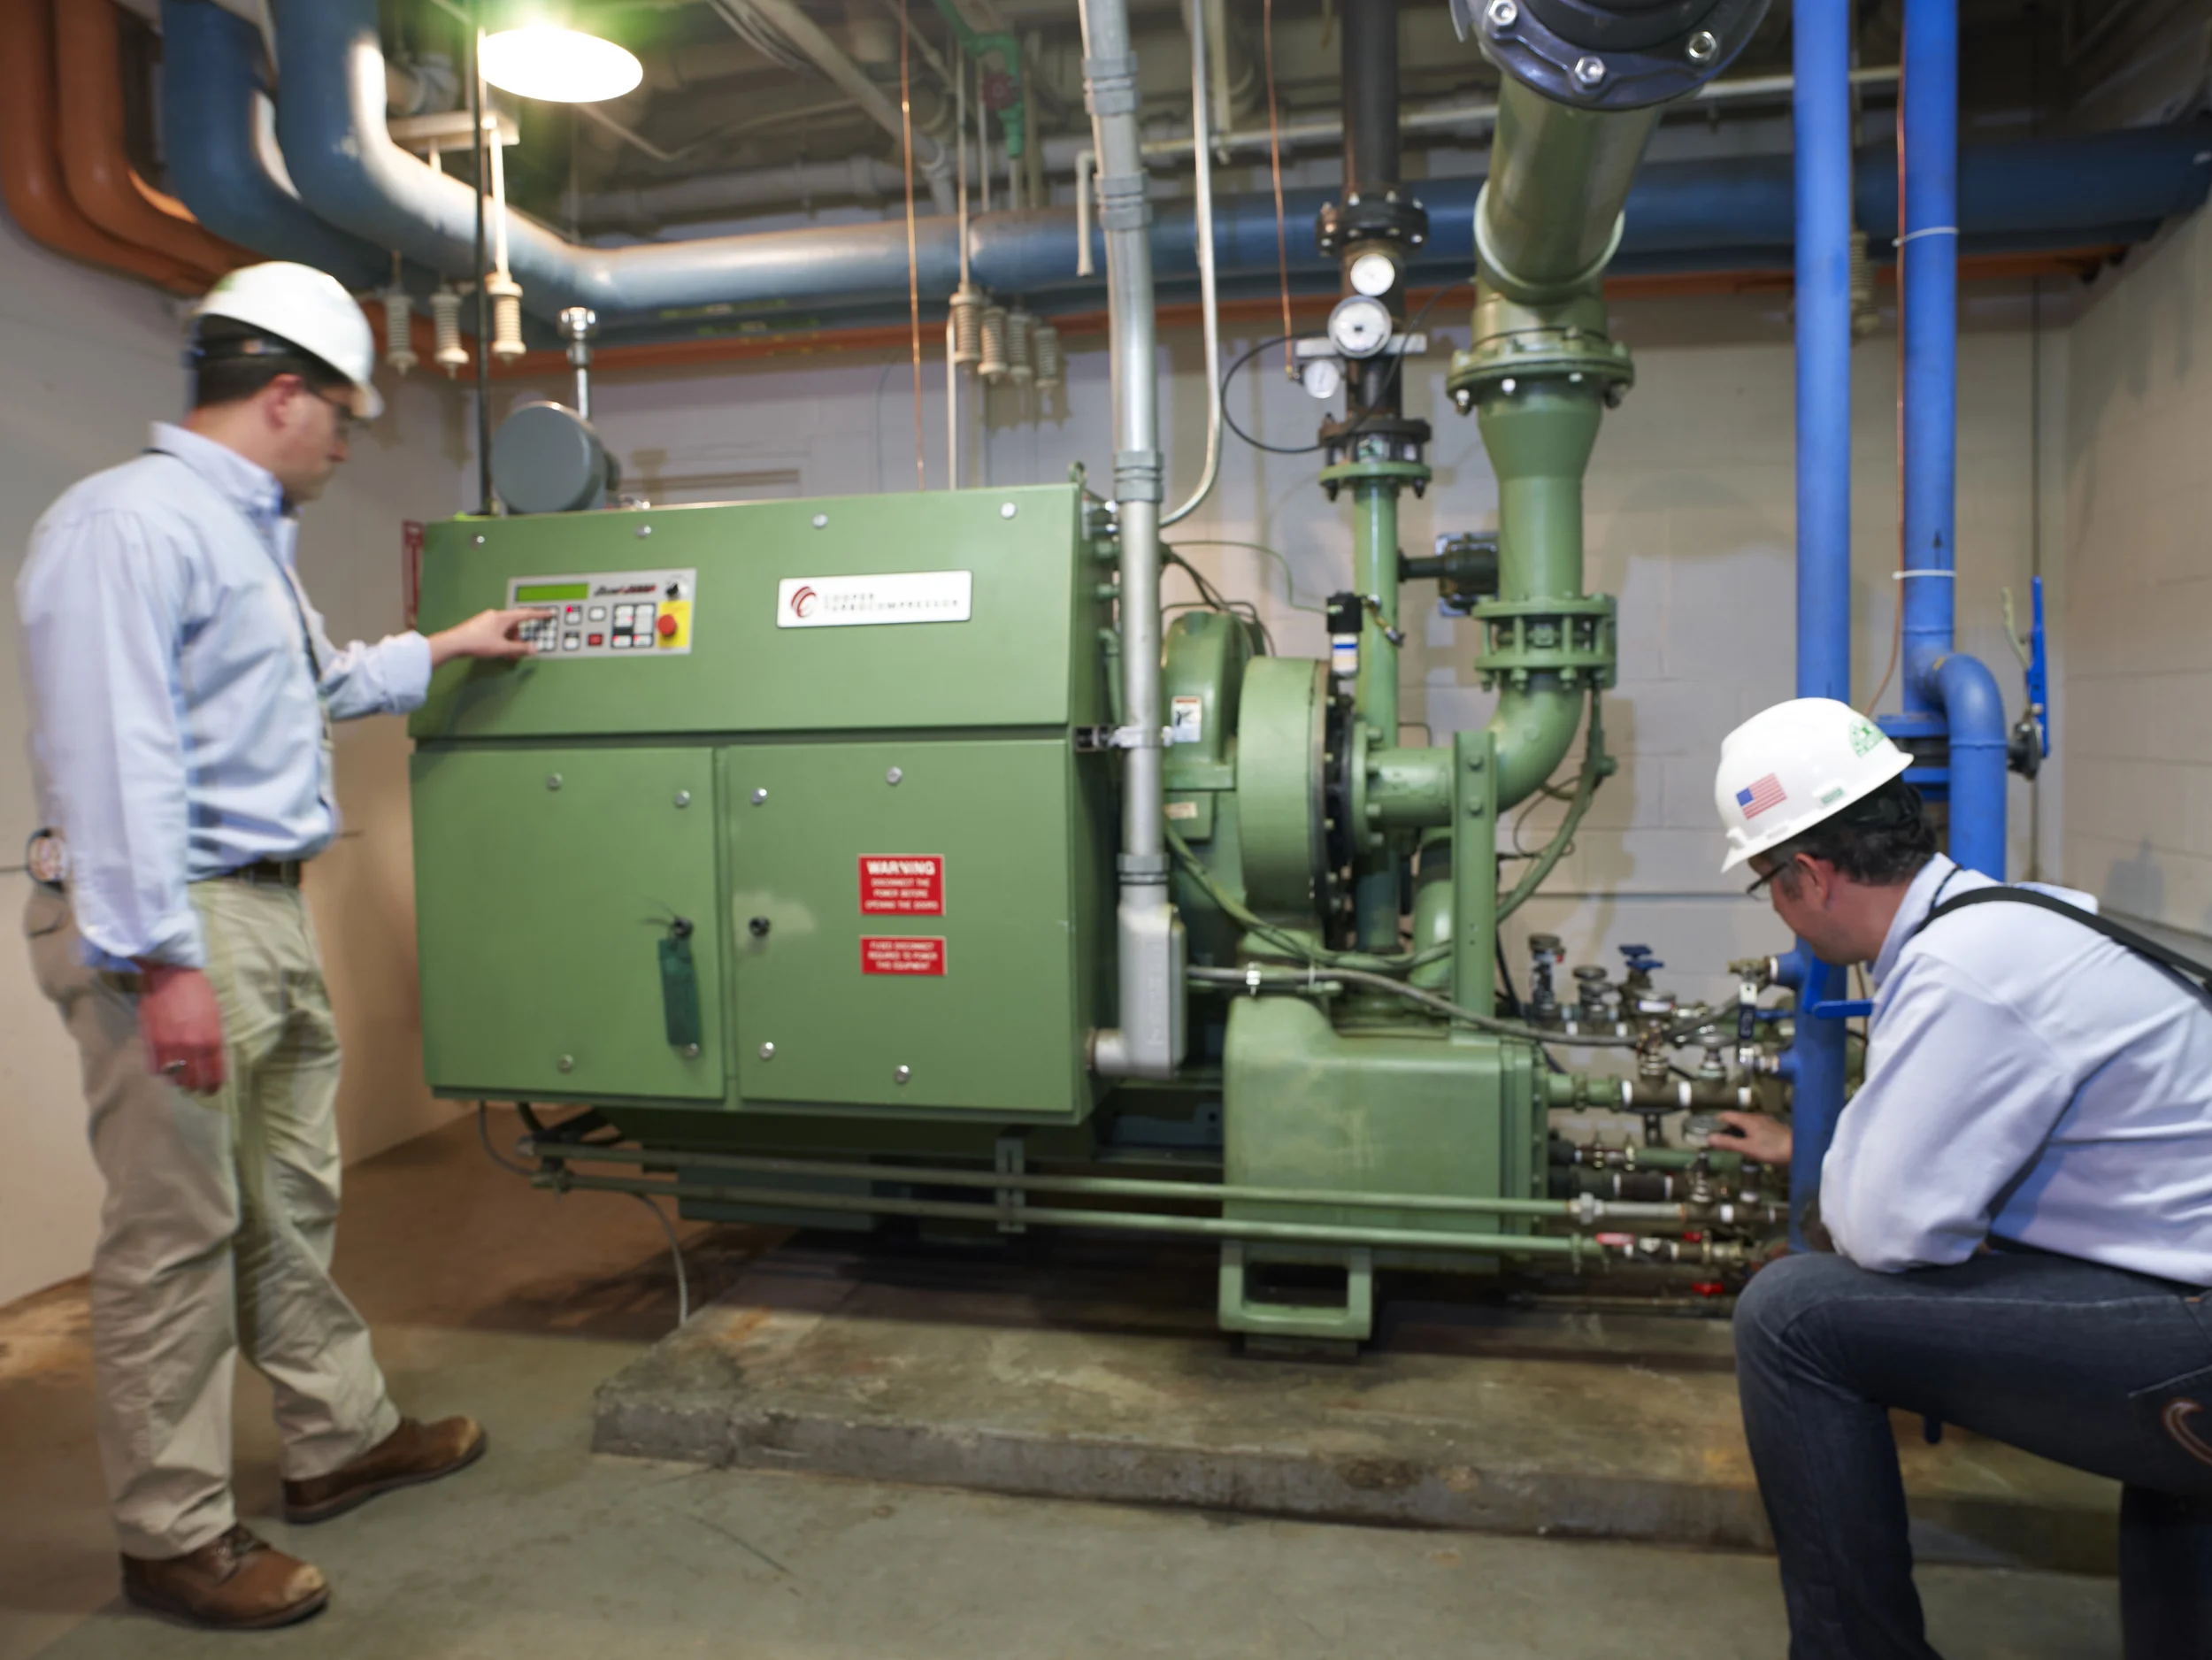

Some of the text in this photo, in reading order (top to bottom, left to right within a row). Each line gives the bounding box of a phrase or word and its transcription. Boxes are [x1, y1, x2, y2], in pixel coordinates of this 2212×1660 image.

[866, 860, 935, 875] WARNING
[871, 878, 930, 888] DISCONNECT THE
[873, 888, 928, 898] POWER BEFORE
[897, 900, 911, 910] THE
